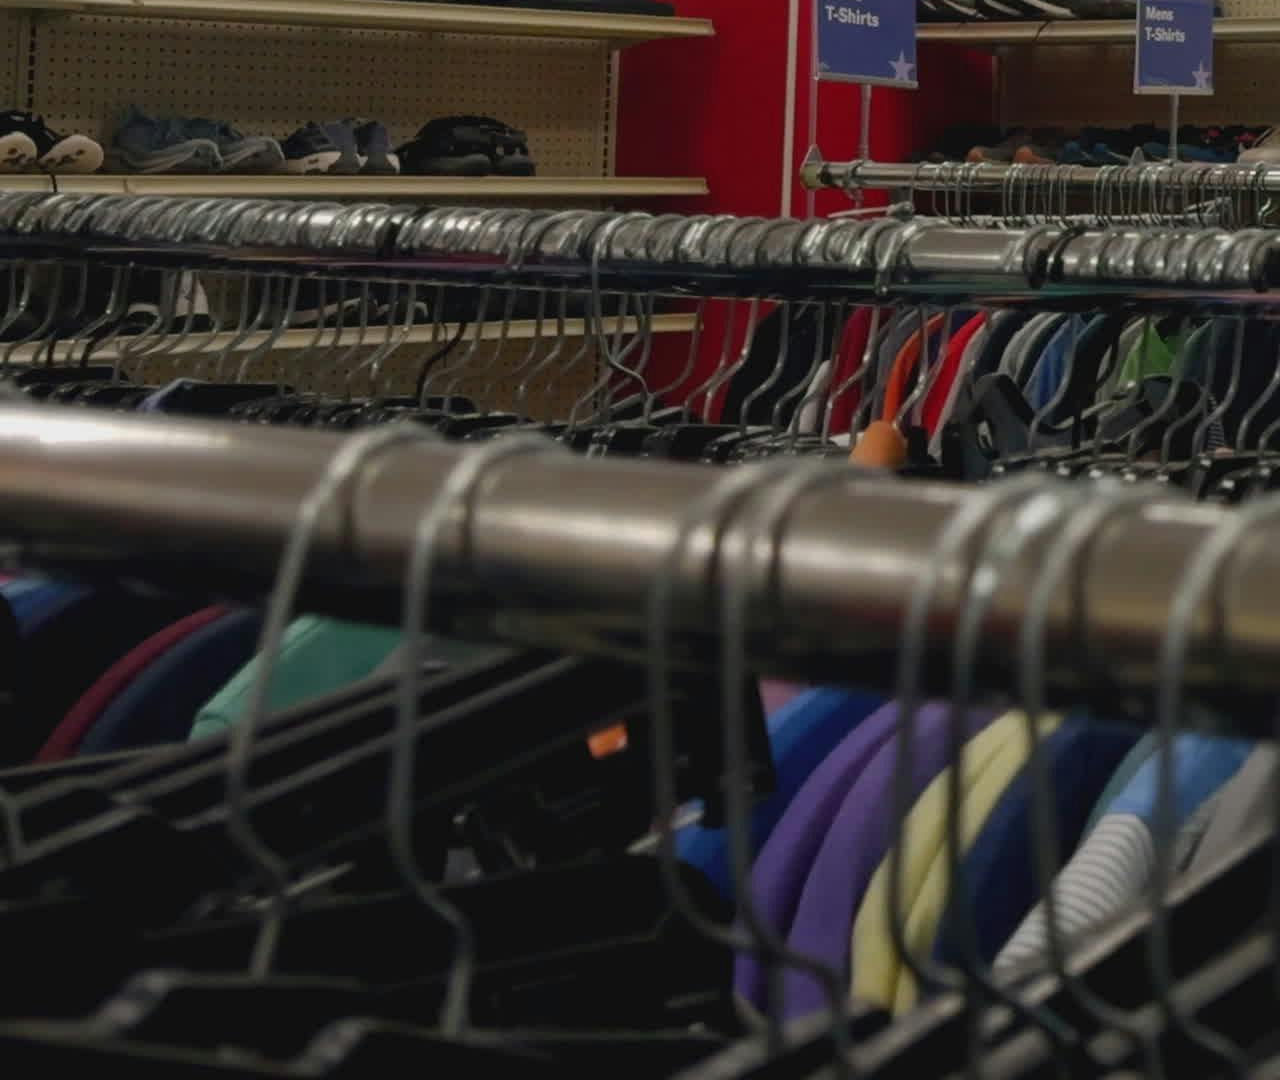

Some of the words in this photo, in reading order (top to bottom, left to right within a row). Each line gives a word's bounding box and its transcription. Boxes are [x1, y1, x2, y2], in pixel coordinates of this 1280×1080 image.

[825, 4, 880, 27] T-Shirts
[1145, 6, 1175, 22] Mens
[1144, 26, 1185, 43] T-Shirts
